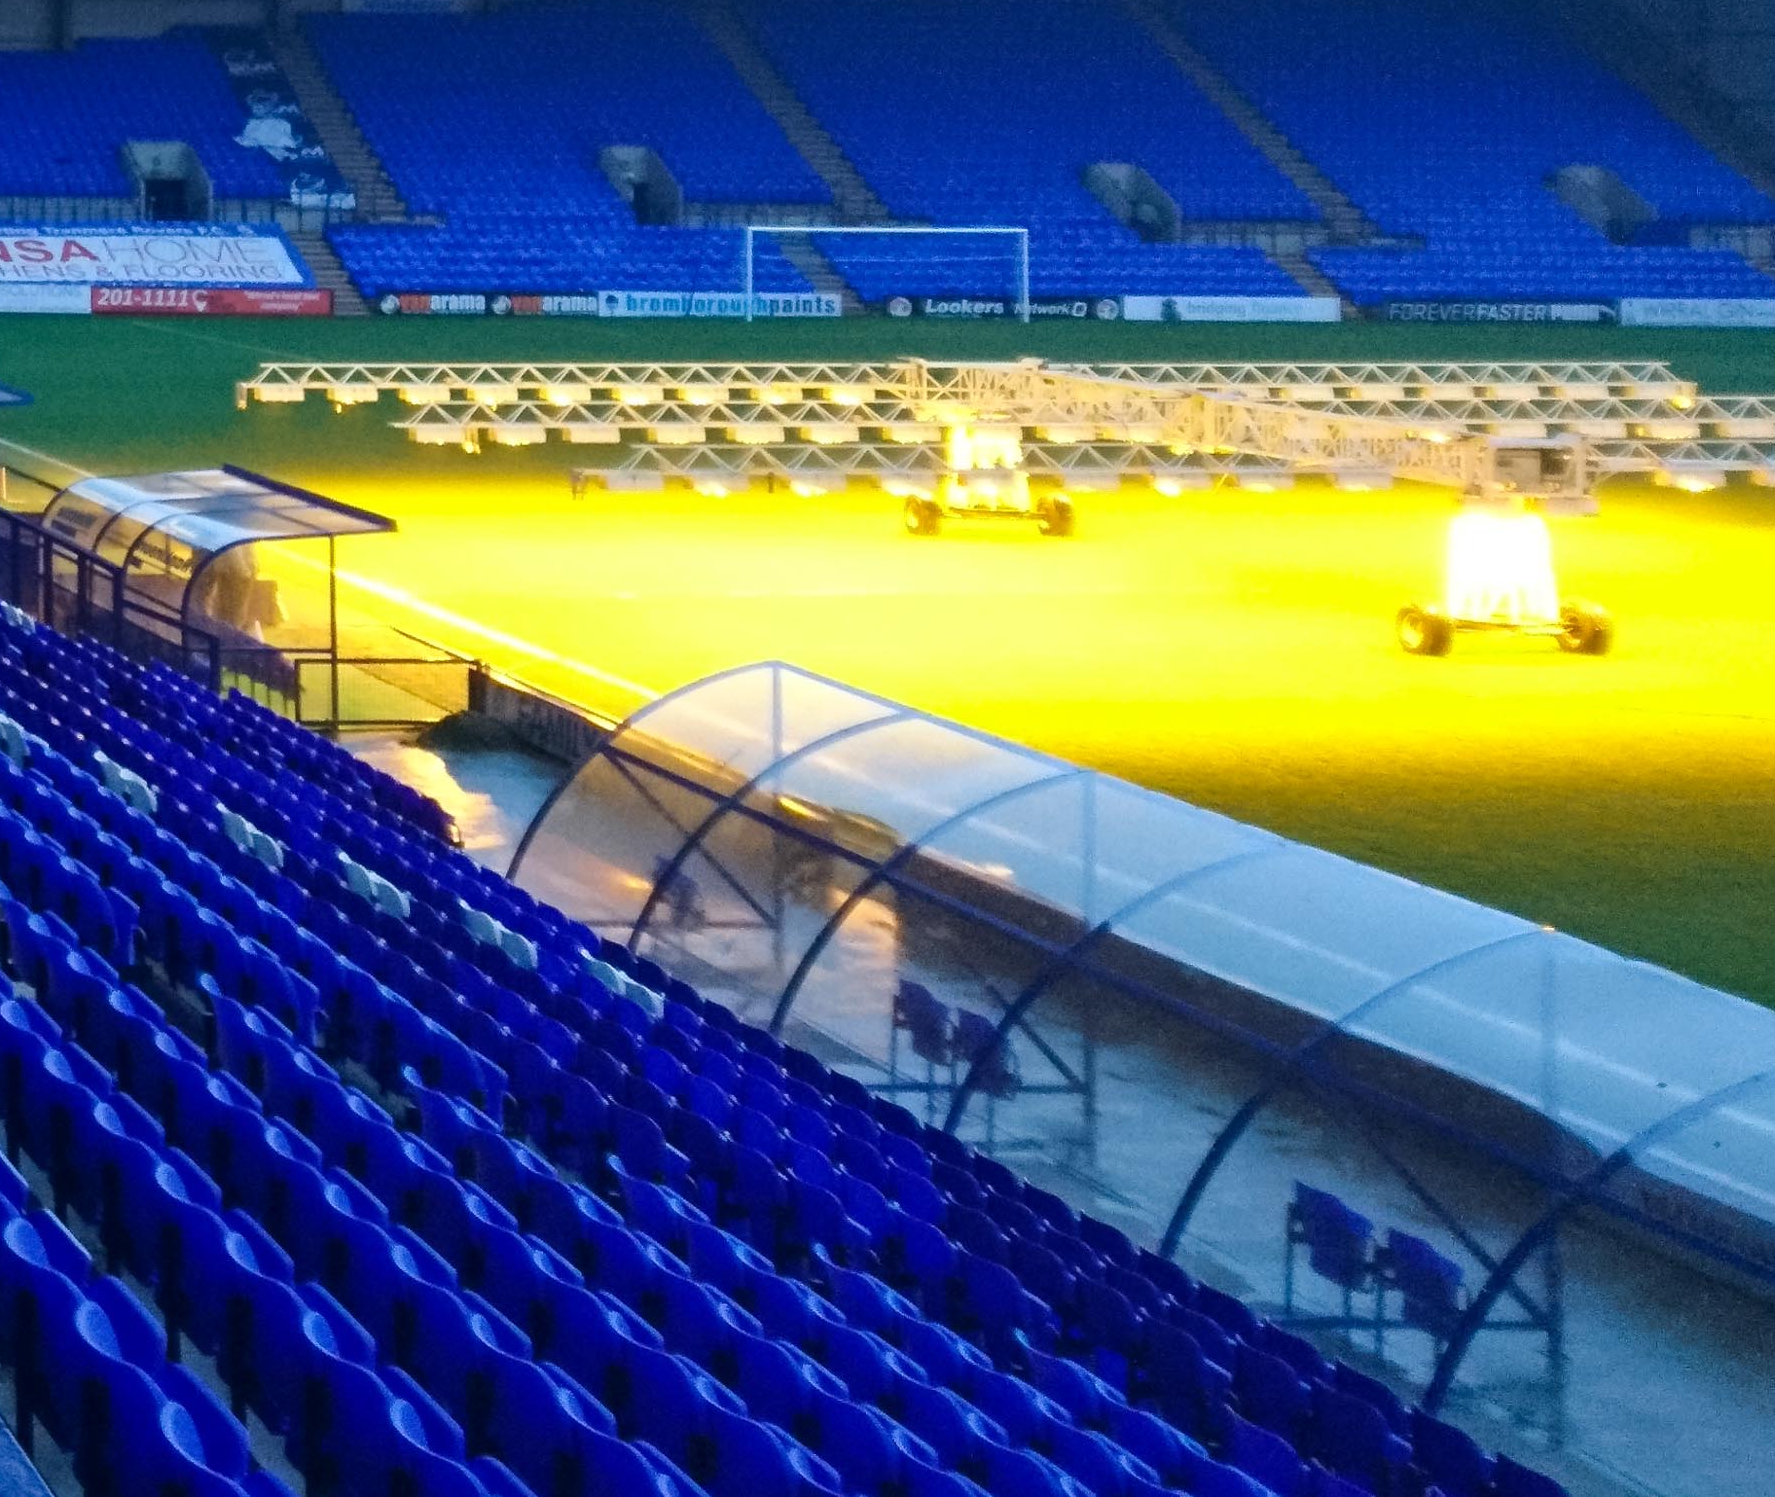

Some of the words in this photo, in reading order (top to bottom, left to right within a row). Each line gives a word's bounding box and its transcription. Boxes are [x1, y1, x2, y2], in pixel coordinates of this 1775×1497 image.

[103, 239, 278, 264] HOME
[96, 265, 114, 280] &
[124, 264, 283, 280] FLOORING
[97, 288, 189, 307] 201-1111
[925, 298, 1004, 314] Lookers
